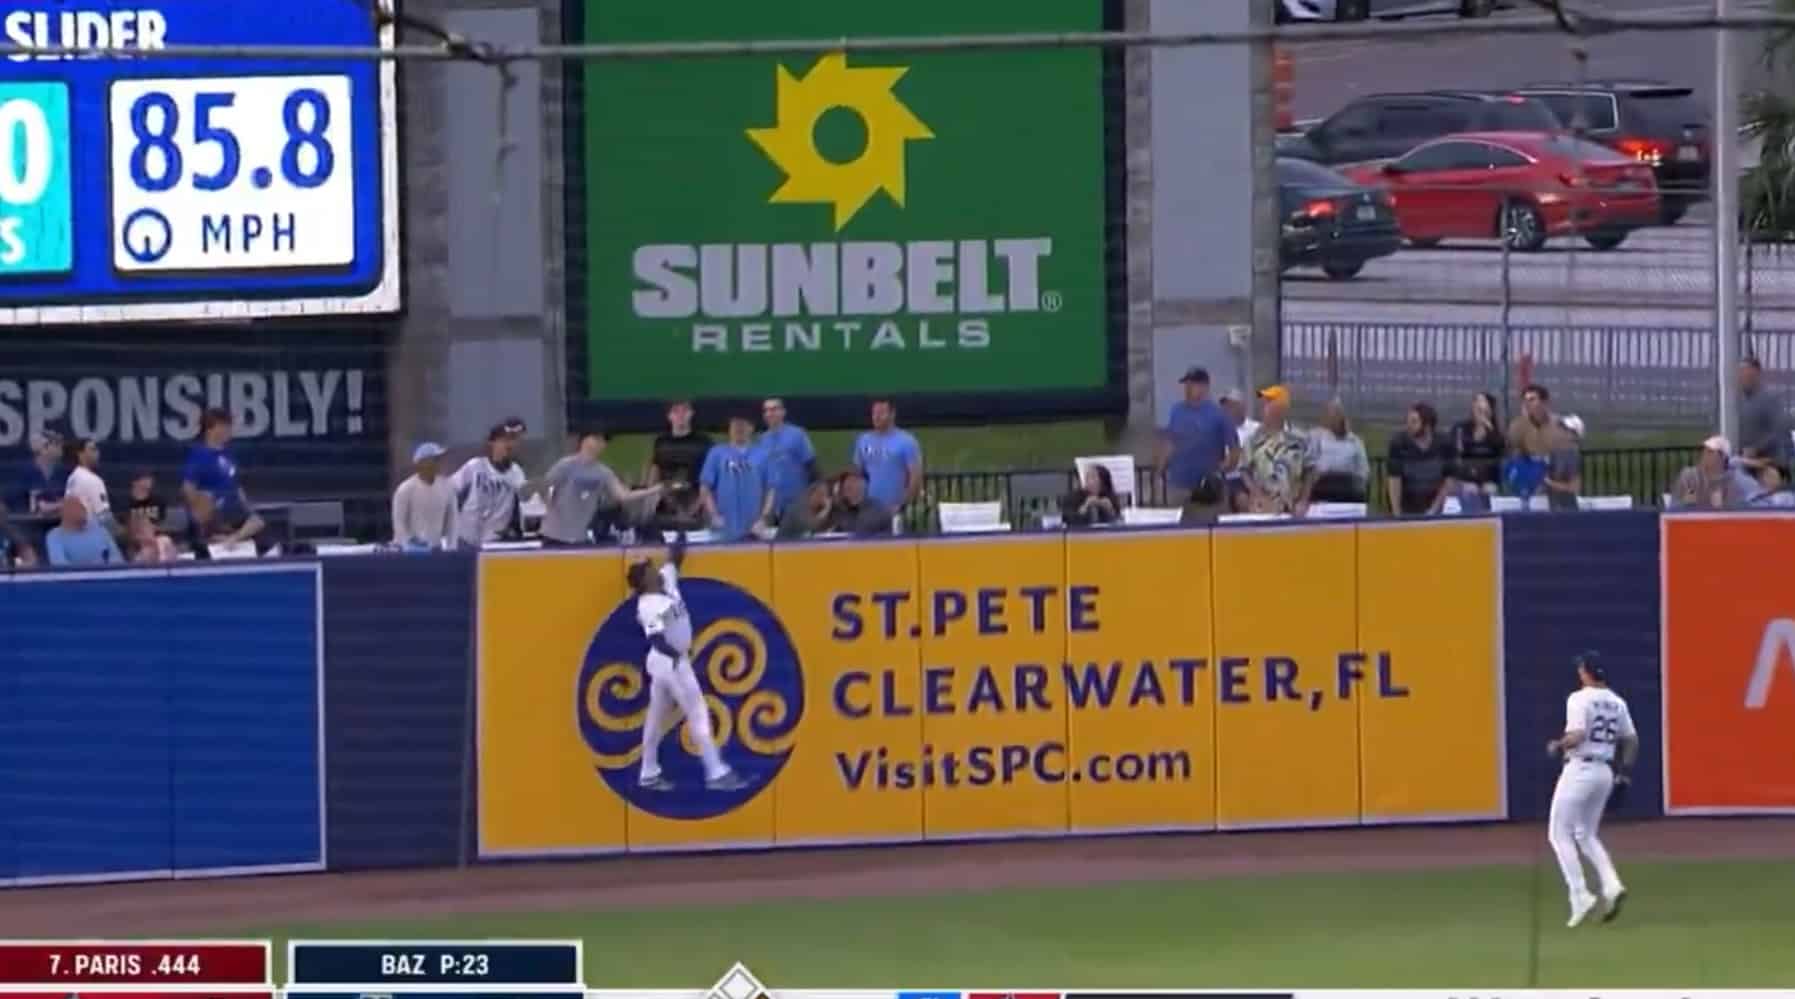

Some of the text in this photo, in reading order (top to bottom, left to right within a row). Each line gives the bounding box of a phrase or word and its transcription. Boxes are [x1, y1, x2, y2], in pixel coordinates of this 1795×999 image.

[5, 10, 167, 62] SLIDER
[129, 88, 335, 193] 85.8
[202, 213, 296, 254] MPH
[632, 237, 1052, 318] SUNBELT
[692, 319, 991, 352] RENTALS
[1590, 715, 1617, 744] 26
[835, 741, 1192, 790] VisitSPC.com
